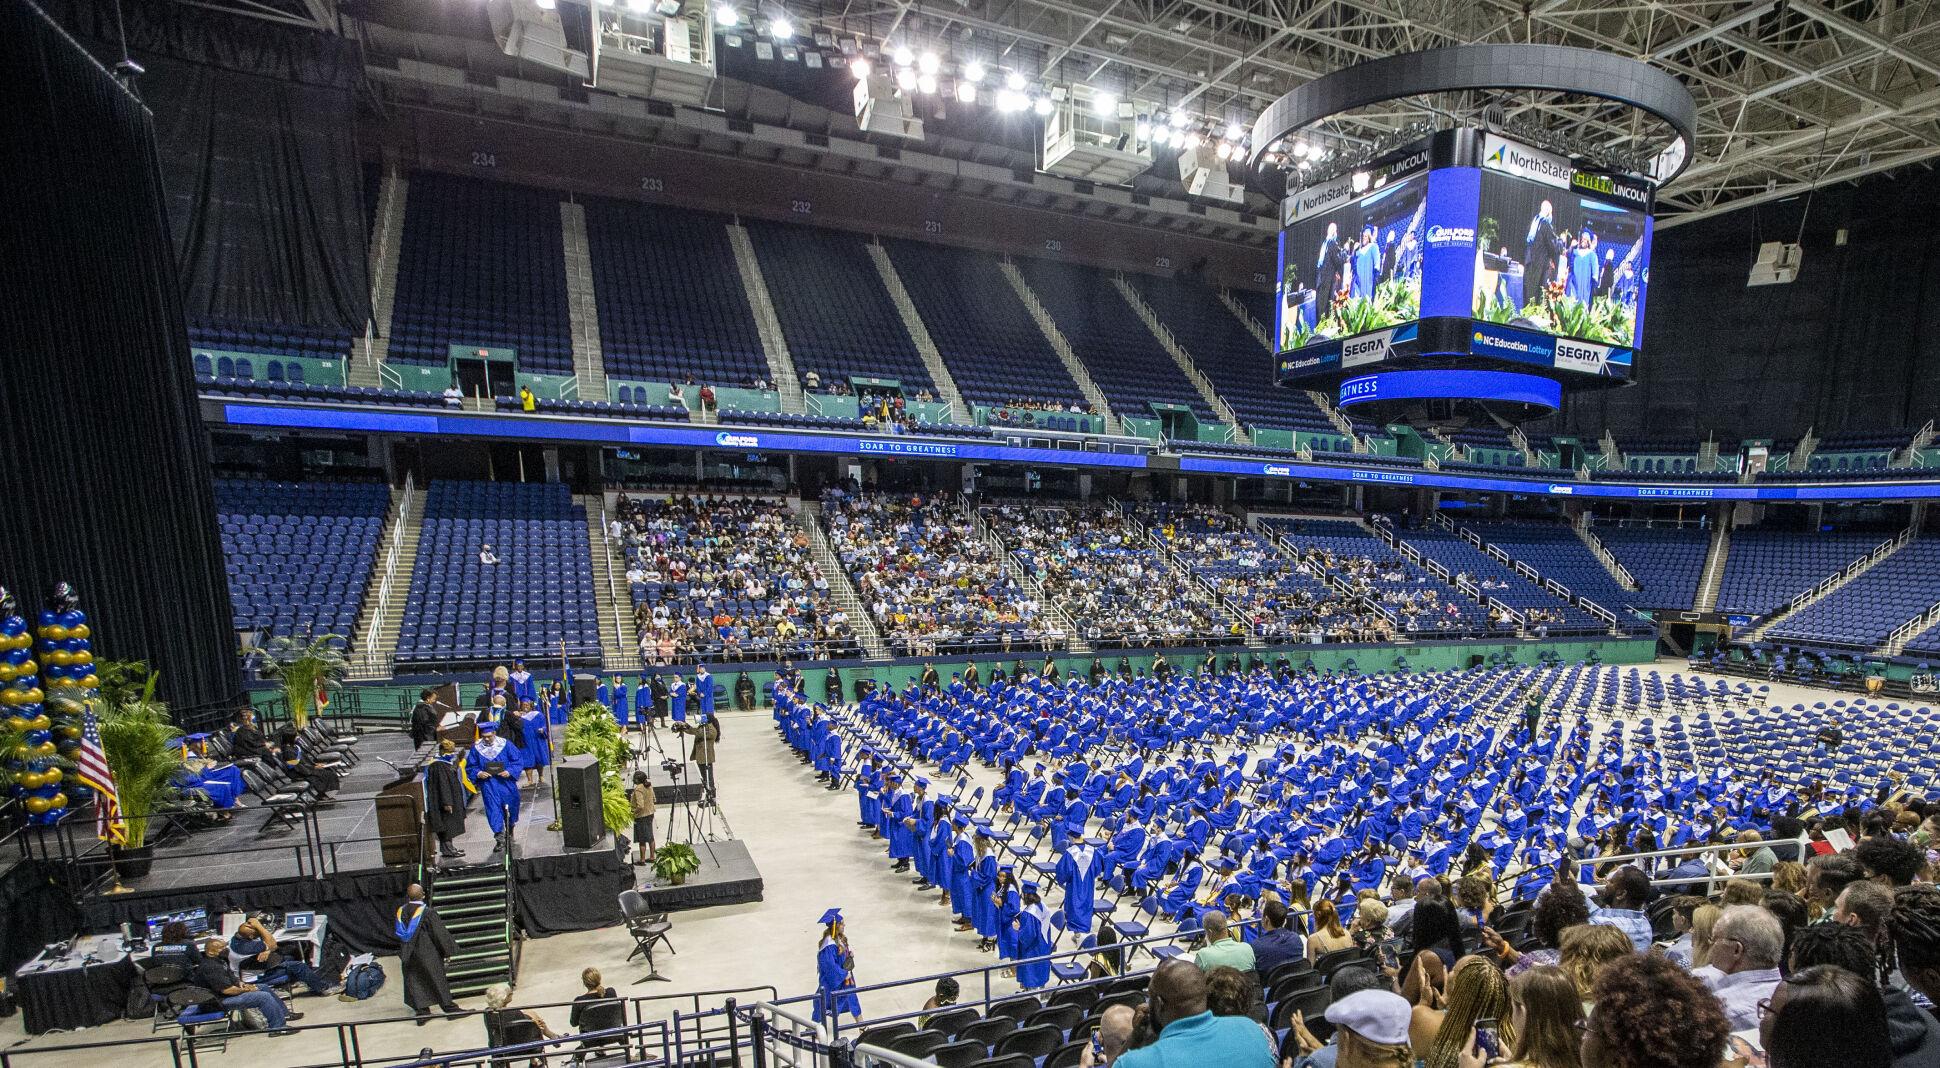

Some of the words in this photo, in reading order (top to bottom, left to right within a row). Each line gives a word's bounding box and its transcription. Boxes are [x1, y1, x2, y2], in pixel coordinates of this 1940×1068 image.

[472, 152, 495, 167] 234
[1391, 151, 1428, 175] LINCOLN
[1510, 150, 1569, 180] NorthState
[641, 177, 663, 192] 233
[1613, 183, 1647, 203] LINCOLN
[792, 200, 811, 213] 232
[1303, 184, 1349, 211] NorthState
[925, 220, 941, 233] 231
[1045, 240, 1061, 251] 230
[1345, 339, 1384, 357] SEGRA
[1483, 335, 1495, 346] NC
[1495, 338, 1528, 352] Education
[1528, 343, 1552, 358] Lottery
[1557, 345, 1600, 363] SEGRA
[1287, 360, 1296, 370] NC
[1295, 357, 1321, 369] Education
[1340, 381, 1377, 399] EATNESS
[860, 442, 884, 450] SOAR
[890, 443, 901, 451] TO
[906, 445, 956, 454] GREATNESS
